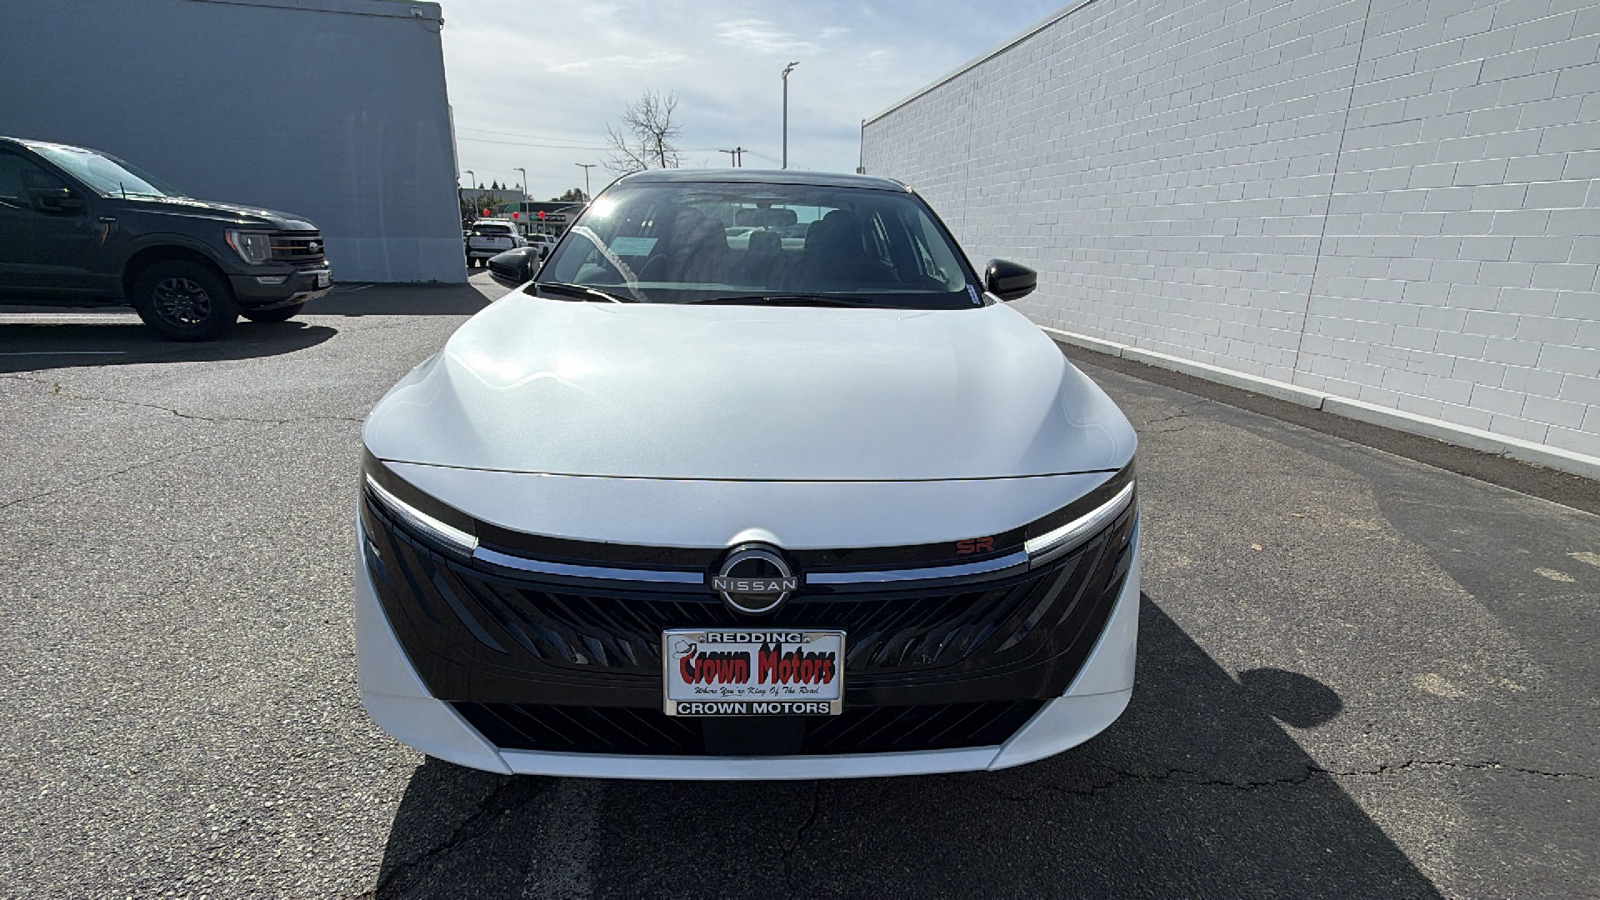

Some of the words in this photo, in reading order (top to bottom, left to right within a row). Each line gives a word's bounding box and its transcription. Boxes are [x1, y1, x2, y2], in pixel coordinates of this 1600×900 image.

[956, 537, 994, 554] SR
[714, 579, 796, 591] NISSAN
[708, 632, 801, 643] REDDING
[680, 643, 750, 685] Crown
[758, 643, 835, 685] Motors
[694, 686, 718, 694] Where
[720, 686, 745, 697] You're
[747, 686, 766, 696] King
[769, 686, 780, 697] Of
[782, 686, 796, 694] The
[799, 686, 820, 694] Road
[677, 702, 747, 714] CROWN
[752, 702, 830, 714] MOTORS
